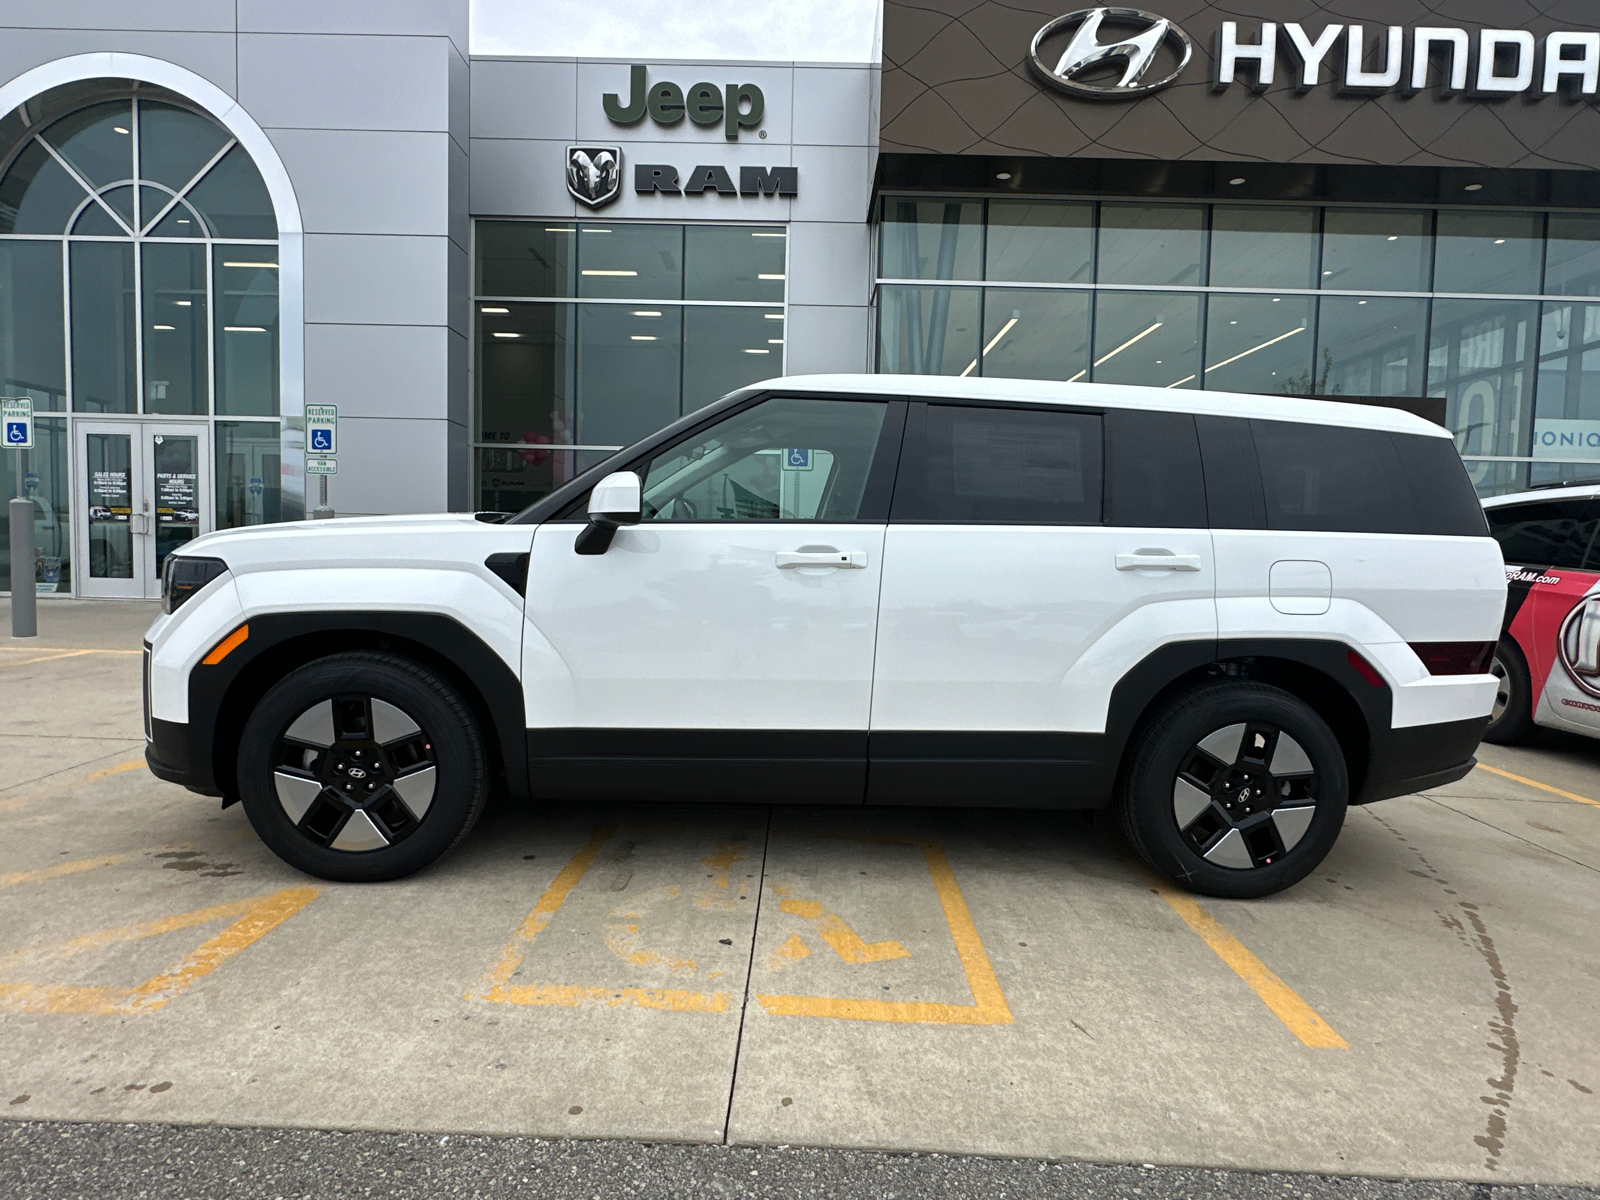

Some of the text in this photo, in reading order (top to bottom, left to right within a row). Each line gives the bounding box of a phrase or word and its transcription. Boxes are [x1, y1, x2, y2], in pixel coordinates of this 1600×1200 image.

[1217, 21, 1600, 96] HYUNDA
[602, 65, 765, 140] Jeep
[634, 164, 799, 197] RAM
[2, 401, 30, 409] RESERVED
[307, 408, 335, 416] RESERVED
[307, 417, 335, 425] PARKING
[1533, 431, 1600, 447] IONIQ
